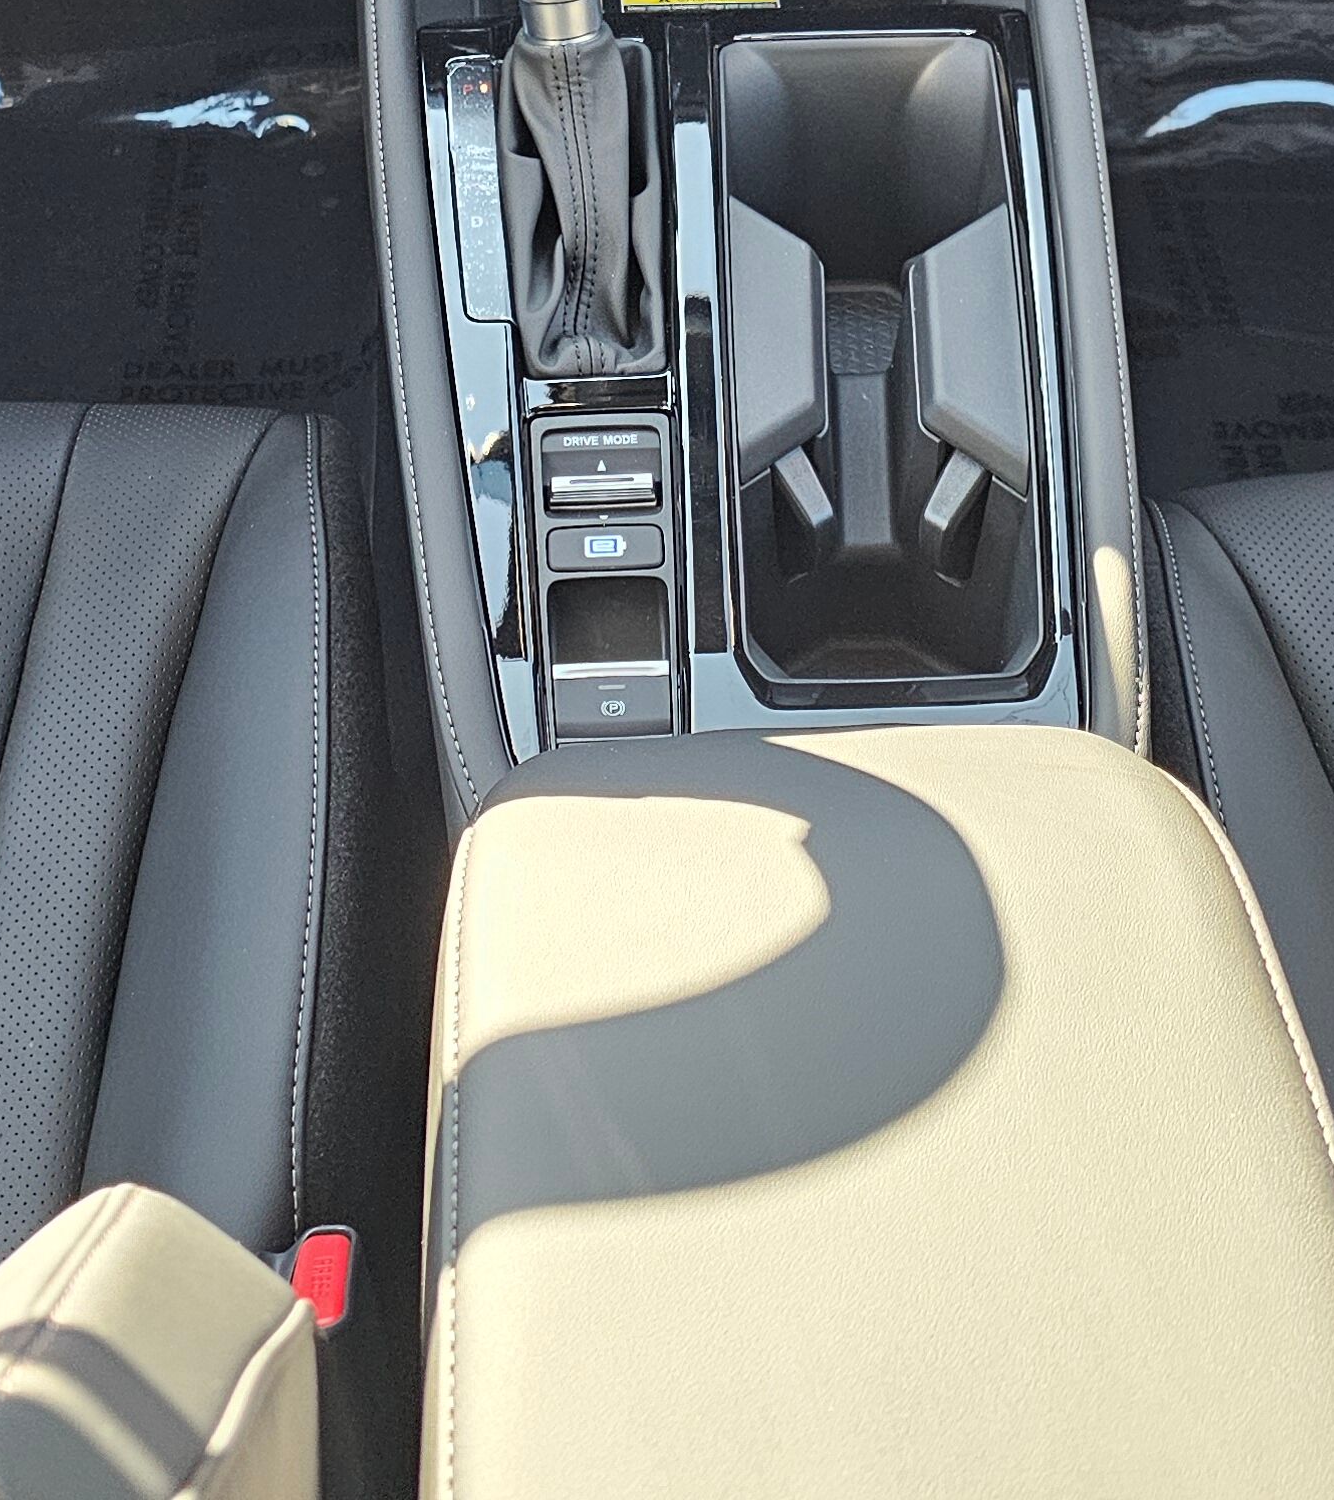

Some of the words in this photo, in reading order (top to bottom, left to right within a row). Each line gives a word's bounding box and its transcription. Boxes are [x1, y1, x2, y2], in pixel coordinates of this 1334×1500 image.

[463, 84, 472, 95] P
[563, 436, 599, 448] DRIVE
[603, 434, 639, 446] MODE
